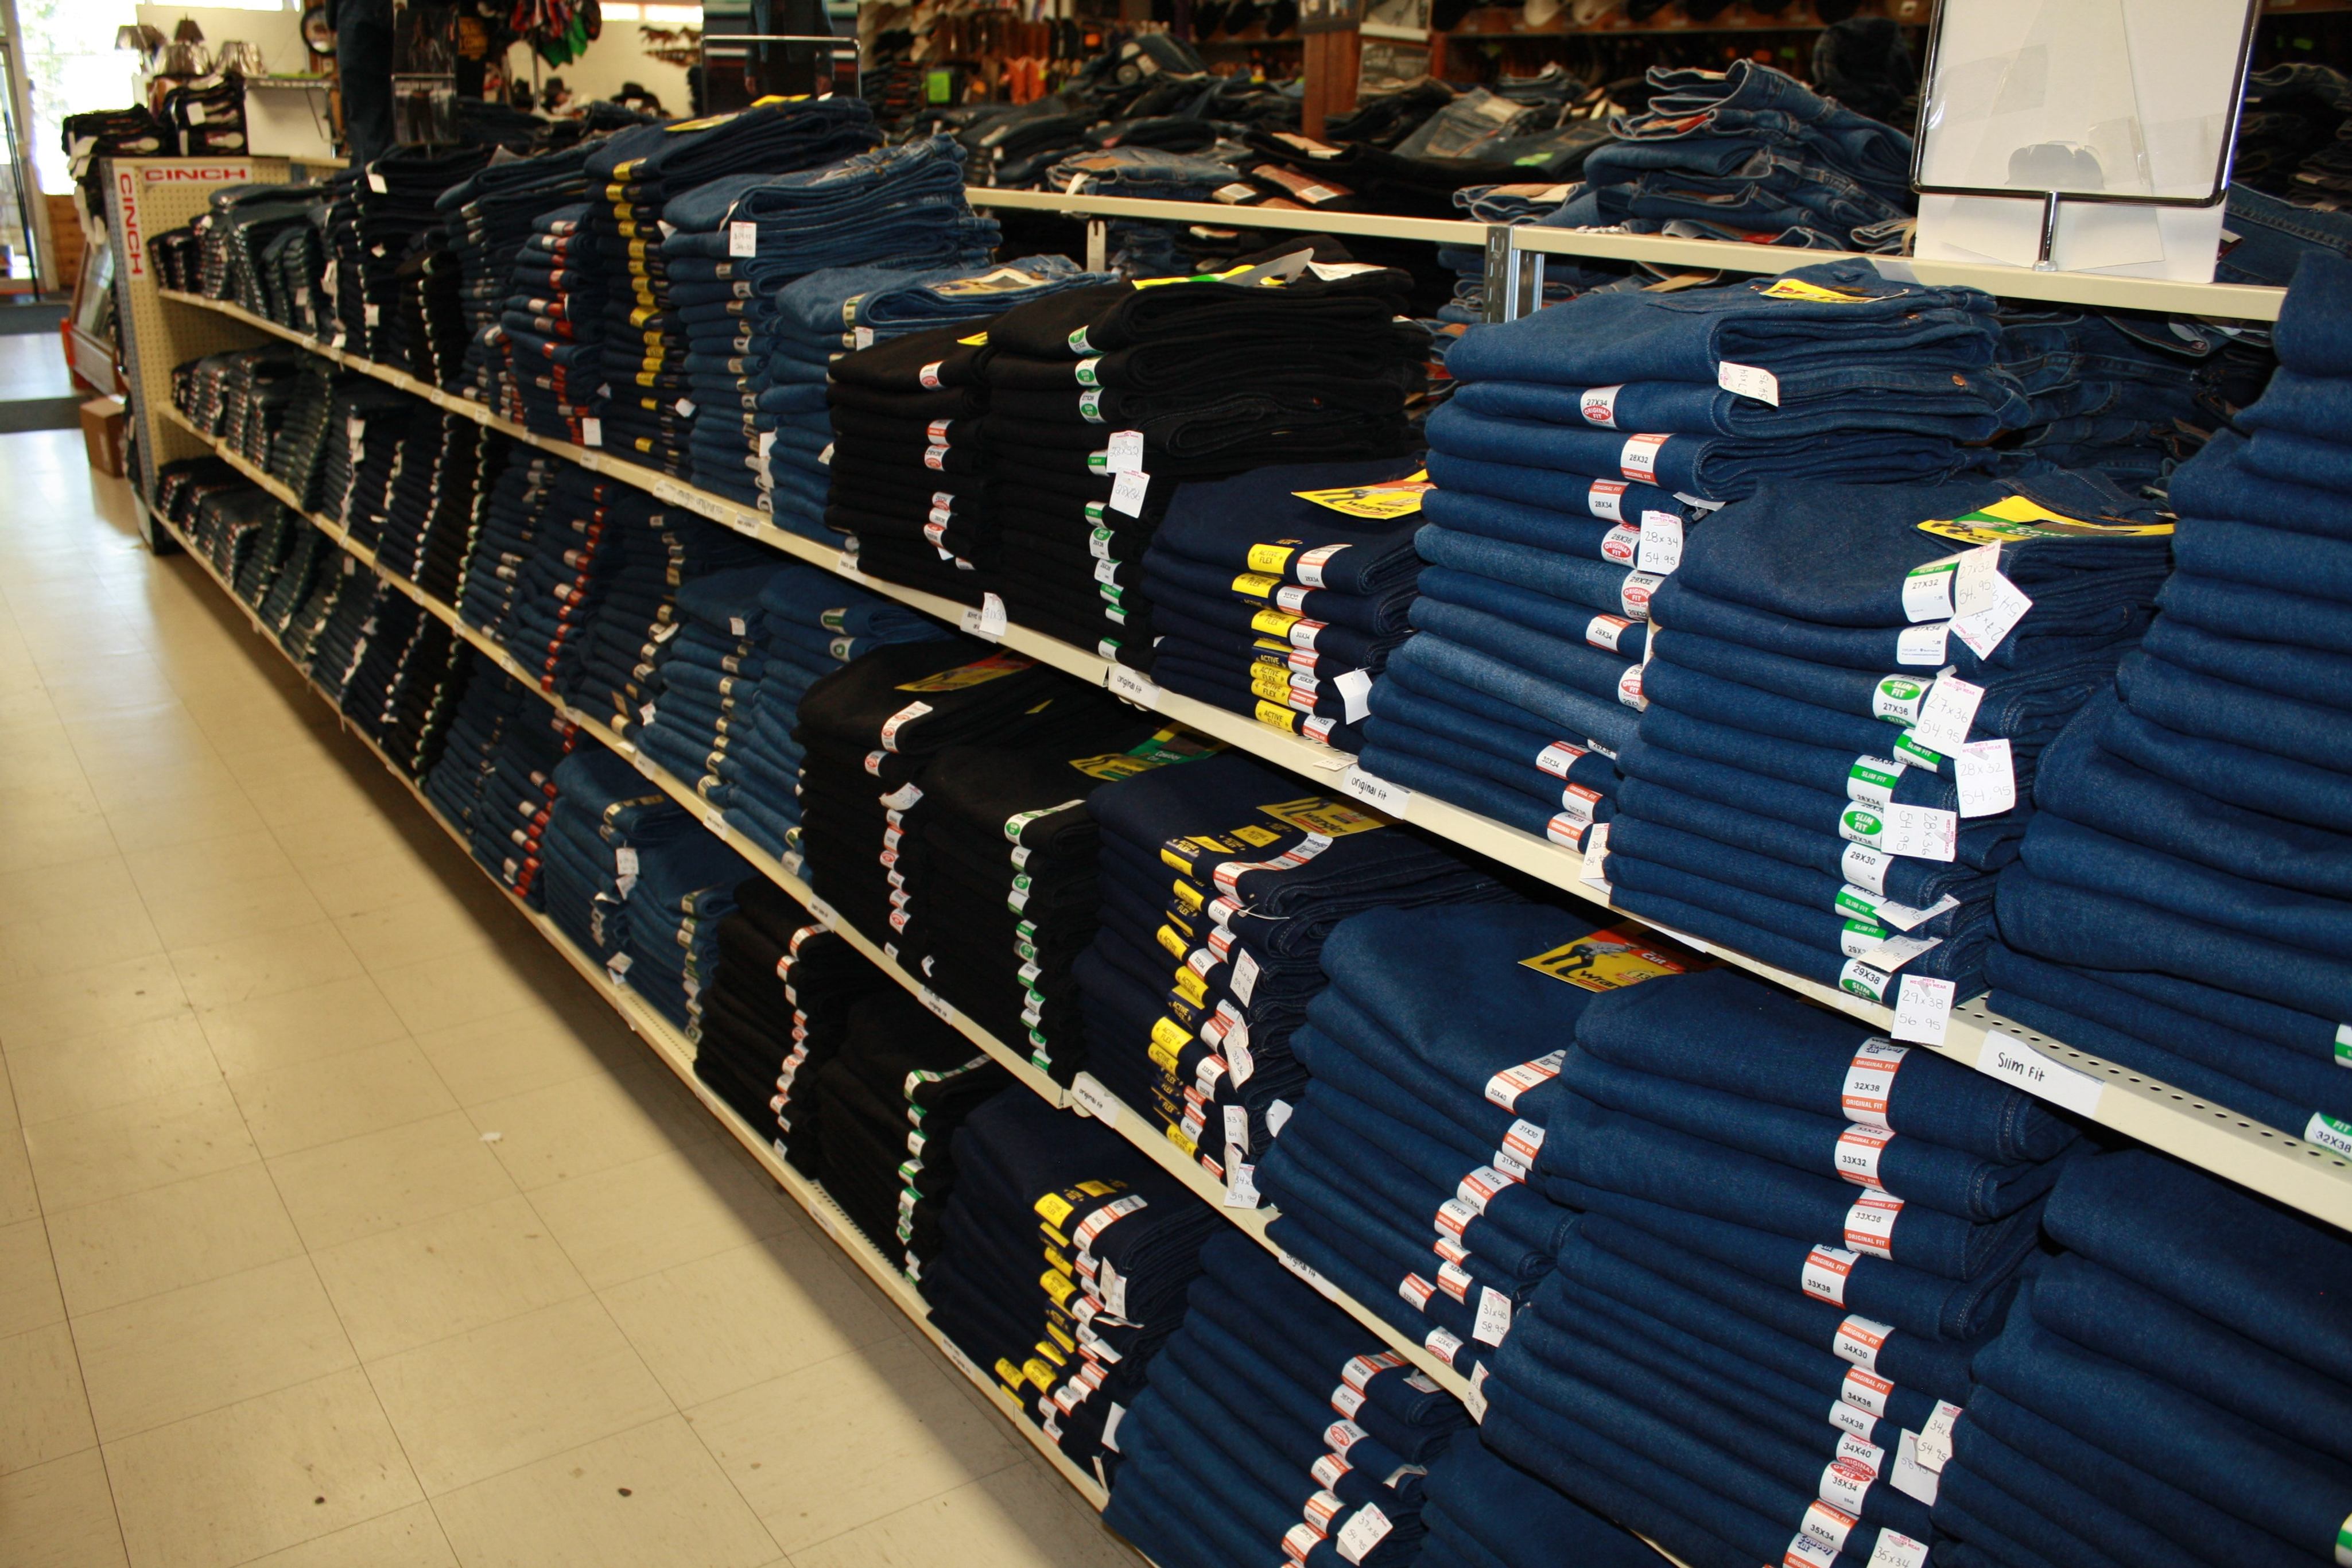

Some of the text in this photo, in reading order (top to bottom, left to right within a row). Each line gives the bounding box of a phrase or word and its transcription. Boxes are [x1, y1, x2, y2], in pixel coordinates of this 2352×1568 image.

[145, 169, 246, 181] CINCH
[119, 173, 143, 275] CINCH
[1584, 407, 1609, 416] ORIGINAL
[1629, 455, 1648, 464] 28X32
[1645, 531, 1678, 548] 28x34
[1604, 542, 1632, 555] ORIGINAL
[1645, 552, 1676, 565] 54.95
[1959, 561, 1991, 580] 27x32
[1629, 576, 1653, 585] 29X32
[1912, 579, 1939, 589] 27X32
[1959, 580, 1991, 604] 54.95
[1264, 618, 1279, 626] FLEX
[1260, 655, 1279, 665] ACTIVE
[1260, 666, 1280, 677] ACTIVE
[1892, 681, 1913, 691] SLIM
[1263, 689, 1276, 697] FLEX
[1891, 689, 1905, 697] FIT
[1883, 703, 1908, 716] 27X36
[1927, 693, 1968, 723] 27x36
[1264, 710, 1283, 722] ACTIVE
[1920, 720, 1961, 743] 54.95
[1920, 748, 1932, 757] FIT
[1861, 770, 1876, 781] SLIM
[1960, 763, 2005, 777] 28x32
[1962, 786, 2011, 805] 54.95
[1854, 813, 1874, 825] SLIM
[1570, 829, 1578, 837] FIT
[1854, 822, 1868, 833] FIT
[1896, 810, 1914, 852] 54.95
[1922, 813, 1938, 855] 28x36
[1850, 851, 1876, 865] 29X30
[1177, 905, 1189, 916] FLEX
[1845, 898, 1868, 913] SLIM FIT
[1854, 923, 1868, 933] SLIM
[1641, 953, 1666, 965] Cut
[1853, 965, 1880, 985] 29X38
[1182, 977, 1197, 992] ACTIVE
[1852, 981, 1871, 995] SLIM
[1902, 989, 1944, 1009] 29x38
[1173, 1002, 1189, 1016] ACTIVE
[1898, 1012, 1941, 1031] 56.95
[1161, 1033, 1172, 1044] FLEX
[1163, 1025, 1179, 1040] ACTIVE
[1155, 1051, 1170, 1065] ACTIVE
[1856, 1059, 1883, 1068] ORIGINAL
[1997, 1052, 2024, 1076] Slim
[1165, 1074, 1176, 1084] FLEX
[1854, 1082, 1880, 1092] 32X38
[1163, 1102, 1174, 1113] FLEX
[1846, 1099, 1872, 1108] ORIGINAL
[2332, 1120, 2351, 1132] FIT
[1174, 1133, 1189, 1146] ACTIVE
[1843, 1135, 1869, 1143] ORIGINAL
[2316, 1131, 2351, 1152] 32X38
[1526, 1146, 1534, 1155] FIT
[1842, 1155, 1866, 1167] 33X32
[1482, 1188, 1491, 1197] FIT
[1859, 1200, 1887, 1208] ORIGINAL
[1848, 1233, 1885, 1247] ORIGINAL FIT
[1810, 1255, 1846, 1272] ORIGINAL FIT
[1807, 1279, 1831, 1293] 33X38
[1482, 1321, 1505, 1336] 58.95
[1843, 1325, 1879, 1345] ORIGINAL FIT
[1843, 1343, 1868, 1359] 34X30
[1850, 1371, 1876, 1387] ORIGINAL
[1839, 1414, 1864, 1430] 34X38
[1843, 1442, 1872, 1458] 34X40
[1918, 1442, 1947, 1462] 54.95
[1840, 1457, 1874, 1476] ORIGINAL
[1842, 1470, 1856, 1478] FIT
[1832, 1477, 1858, 1492] 35X34
[1815, 1502, 1851, 1524] ORIGINAL FIT
[1810, 1524, 1834, 1542] 35X34
[1796, 1540, 1812, 1553] Cut
[1800, 1535, 1833, 1555] Cowboy
